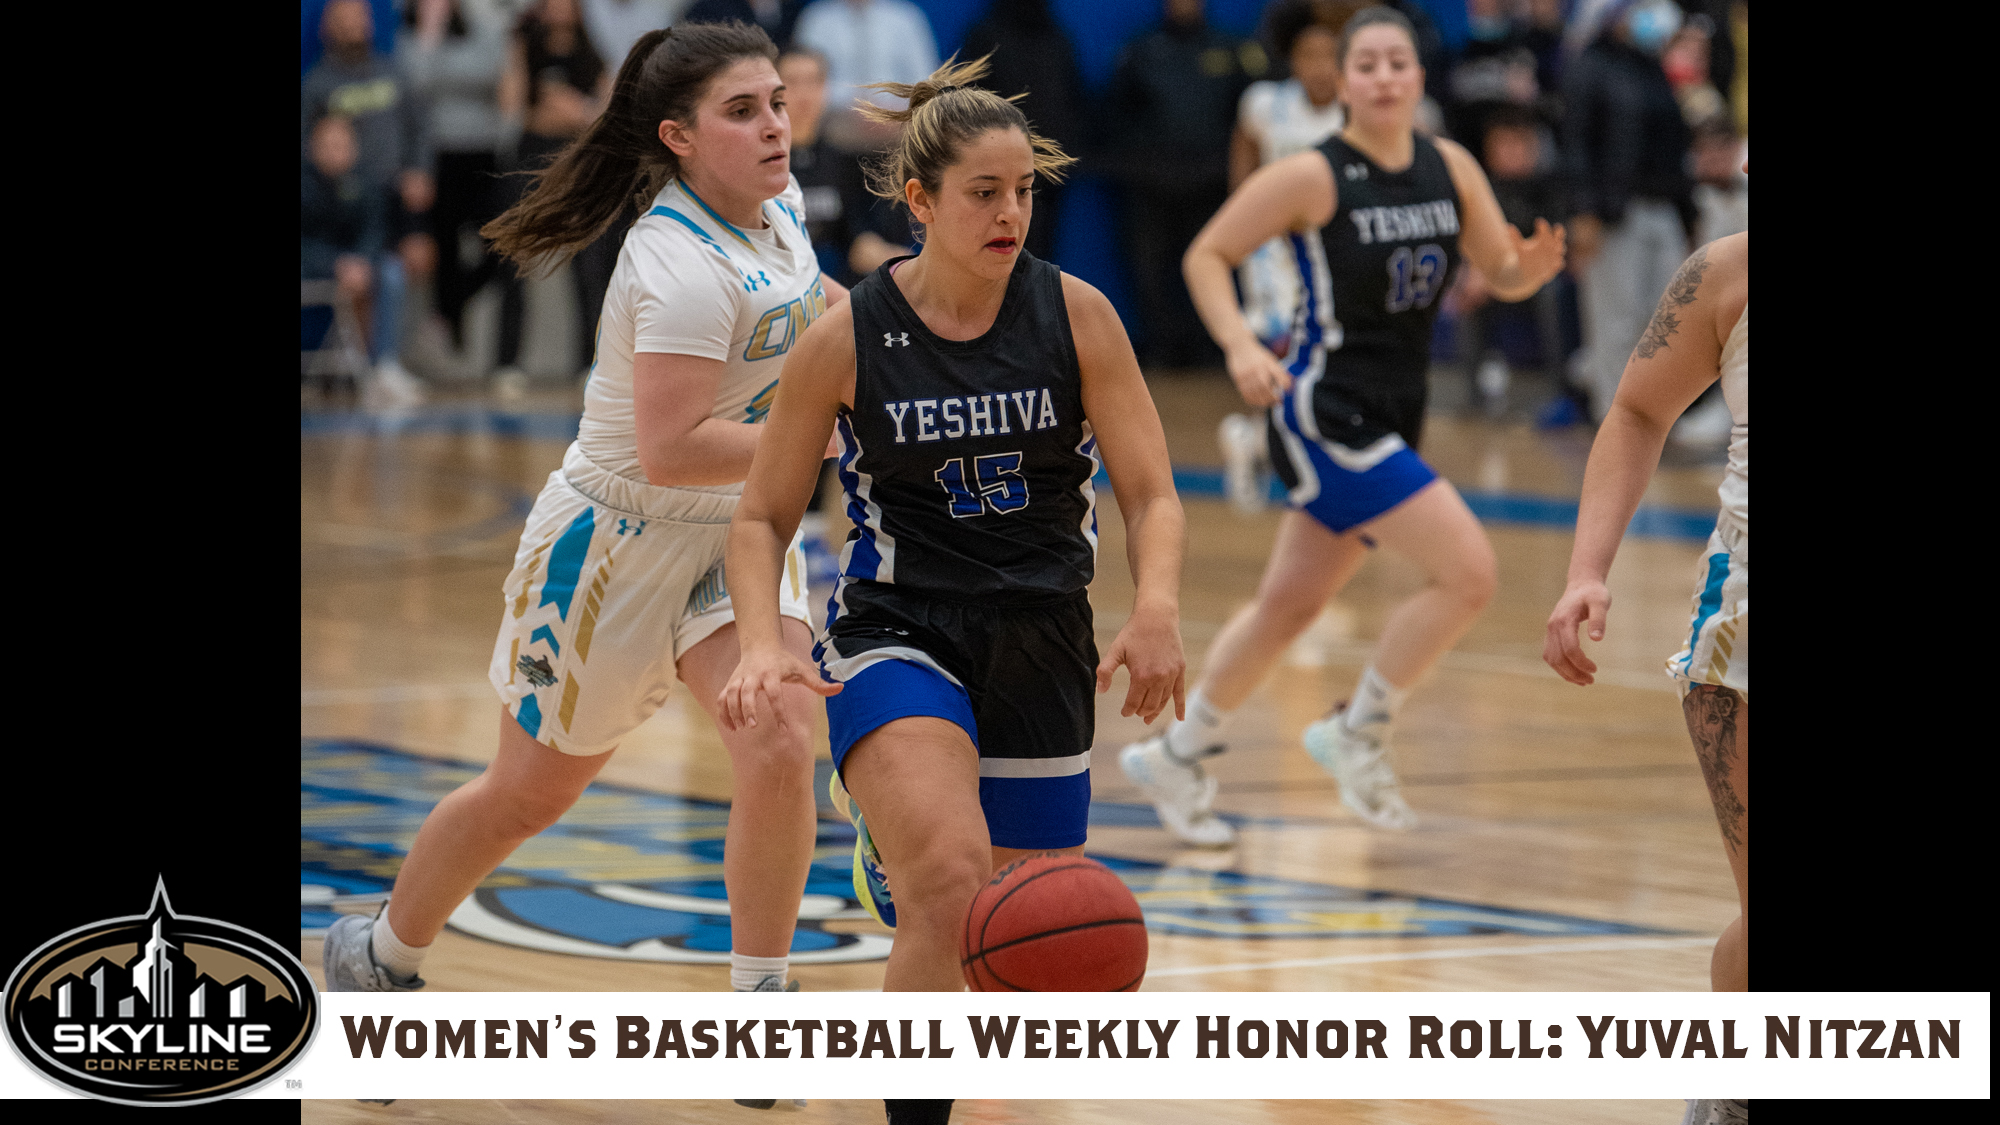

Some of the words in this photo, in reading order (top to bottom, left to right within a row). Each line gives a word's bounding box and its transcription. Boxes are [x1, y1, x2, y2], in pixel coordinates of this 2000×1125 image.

[1350, 199, 1461, 244] YESHIVA
[884, 387, 1058, 443] YESHIVA
[934, 451, 1030, 519] 15
